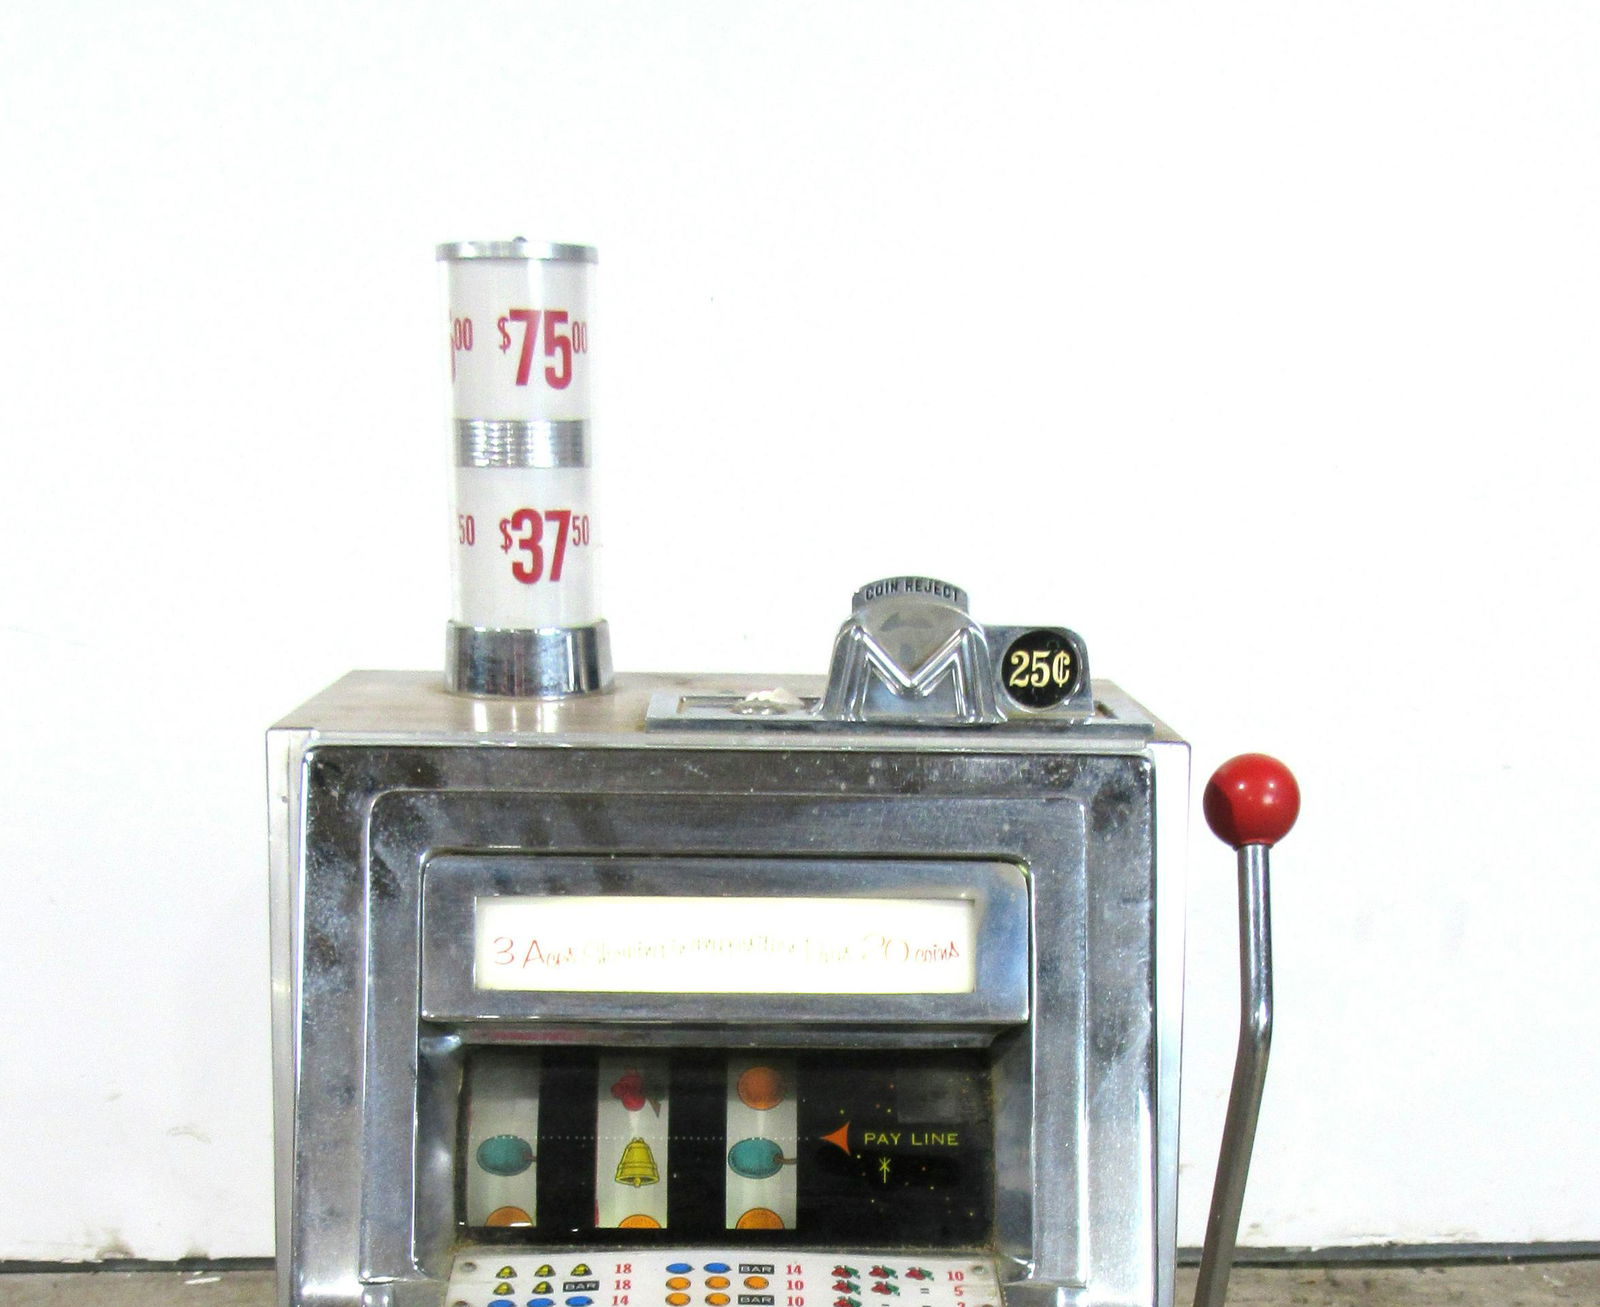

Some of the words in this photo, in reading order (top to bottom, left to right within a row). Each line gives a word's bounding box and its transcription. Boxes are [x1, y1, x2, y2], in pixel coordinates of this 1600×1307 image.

[865, 579, 900, 601] COIN
[905, 579, 959, 602] REJECT
[1009, 650, 1070, 688] 25¢
[494, 937, 514, 965] 3
[864, 1133, 901, 1145] PAY
[911, 1133, 959, 1145] LINE
[615, 1263, 632, 1274] 18
[740, 1264, 773, 1273] BAR
[786, 1264, 802, 1275] 14
[947, 1271, 964, 1281] 10
[565, 1281, 598, 1291] BAR
[614, 1280, 631, 1290] 18
[786, 1280, 804, 1290] 10
[954, 1287, 963, 1296] 5
[611, 1295, 629, 1306] 14
[739, 1296, 772, 1304] BAR
[786, 1296, 804, 1307] 10
